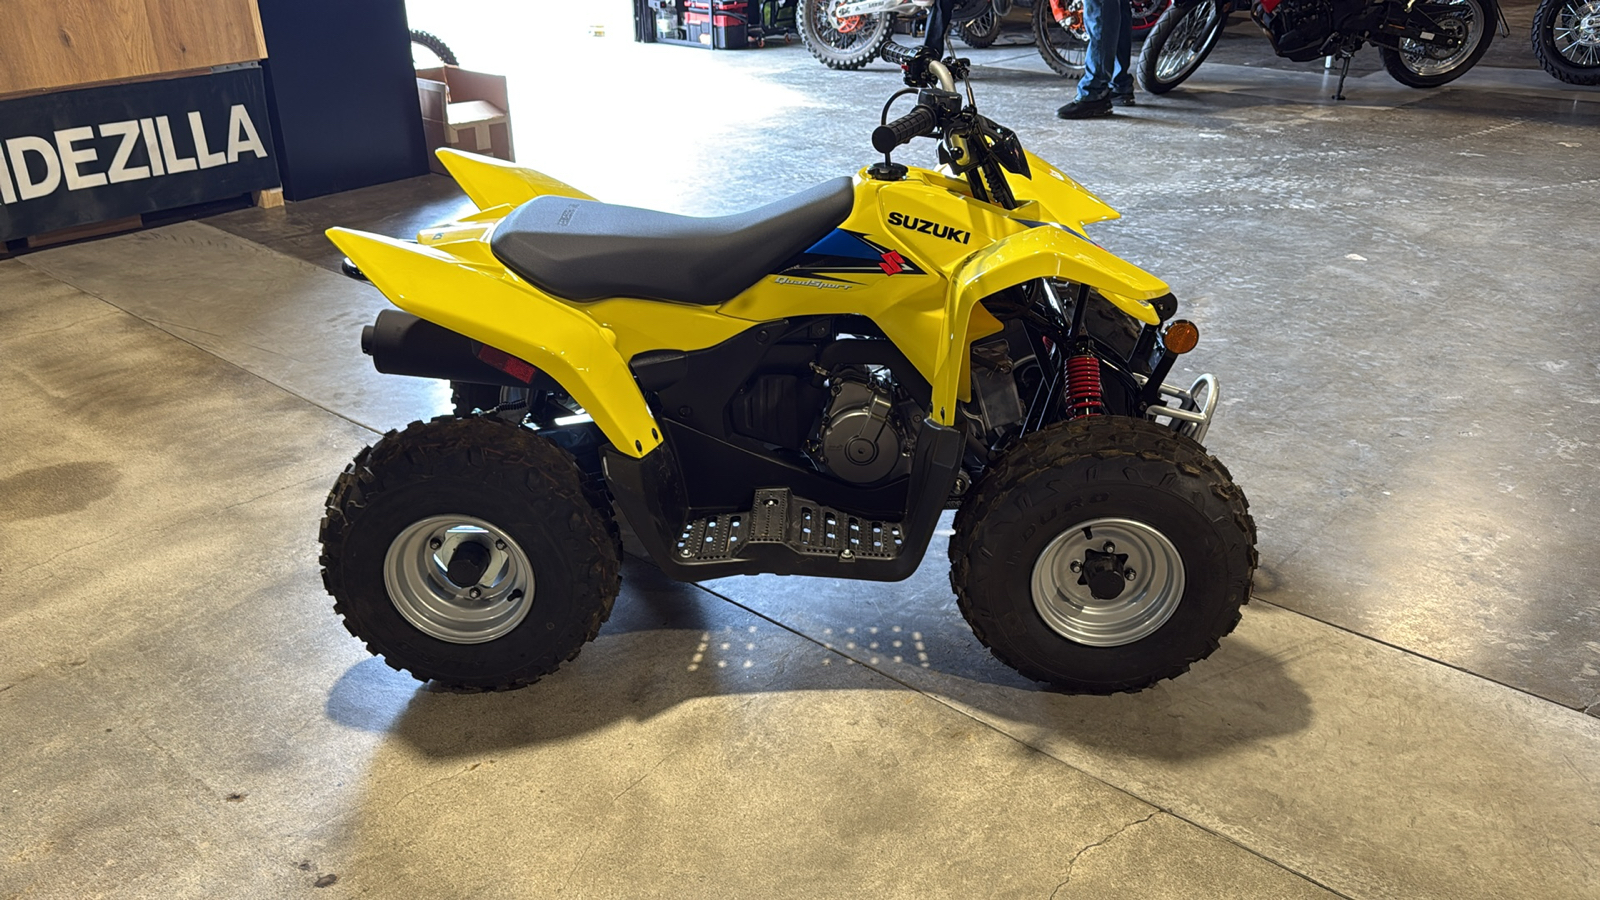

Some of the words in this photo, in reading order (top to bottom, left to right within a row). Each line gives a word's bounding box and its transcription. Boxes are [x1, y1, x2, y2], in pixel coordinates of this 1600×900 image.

[0, 103, 268, 206] IDEZILLA
[887, 211, 971, 245] SUZUKI
[773, 275, 854, 291] QuadSport
[1021, 491, 1111, 543] DURO
